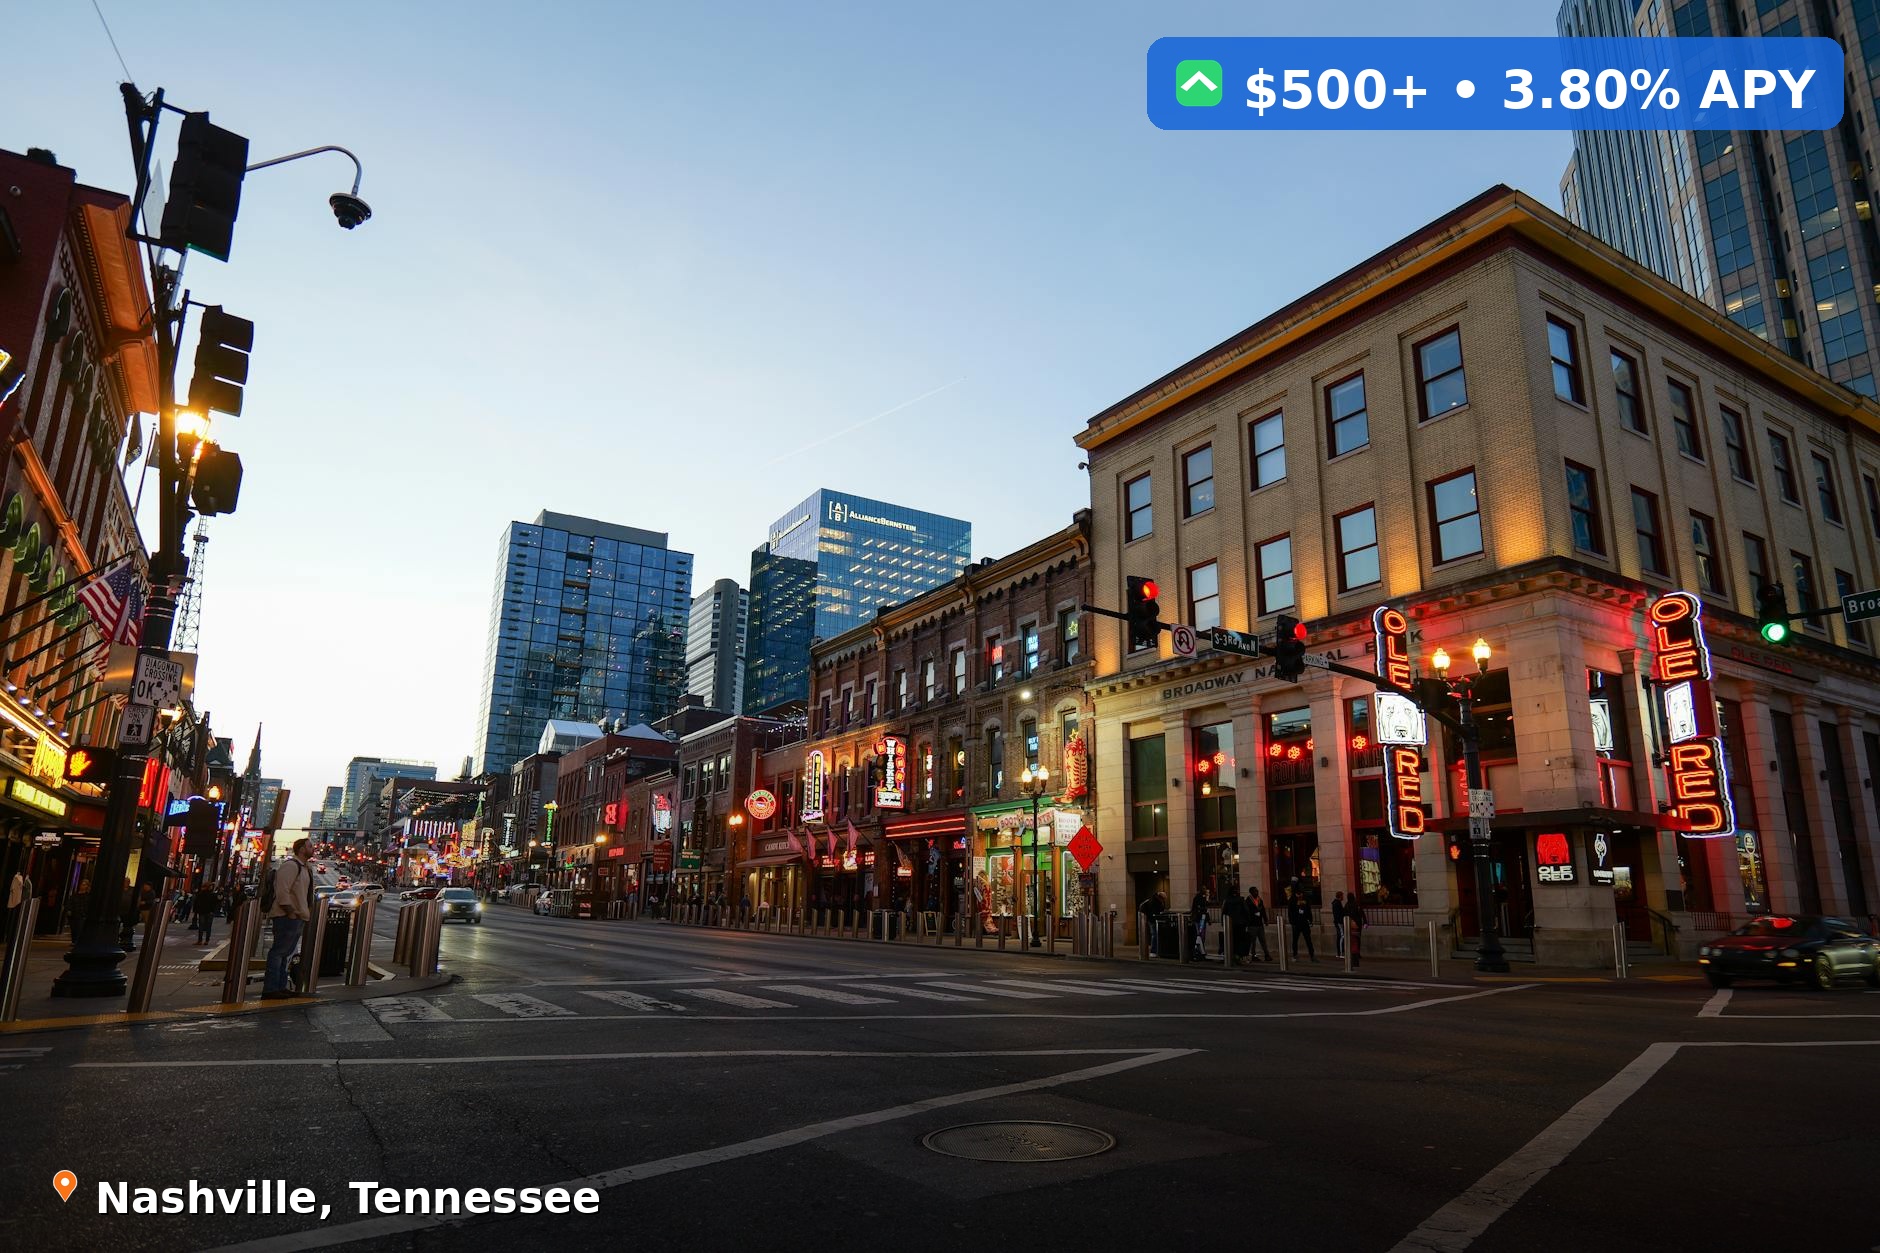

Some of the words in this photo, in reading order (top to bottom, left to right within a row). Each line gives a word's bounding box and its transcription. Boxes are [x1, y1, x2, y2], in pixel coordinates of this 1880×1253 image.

[1384, 610, 1412, 689] OLE
[1651, 597, 1698, 681] OLE
[144, 667, 177, 684] CROSSING
[145, 657, 178, 674] DIAGONAL
[137, 680, 156, 700] OK
[1162, 671, 1245, 700] BROADWAY
[128, 712, 146, 720] ONLY
[885, 739, 896, 792] WHISKEY
[1395, 750, 1424, 833] RED
[1671, 744, 1723, 832] RED
[529, 790, 541, 833] WHISKEY
[1470, 802, 1480, 814] OK
[1537, 865, 1573, 875] OLE
[1538, 873, 1574, 882] RED
